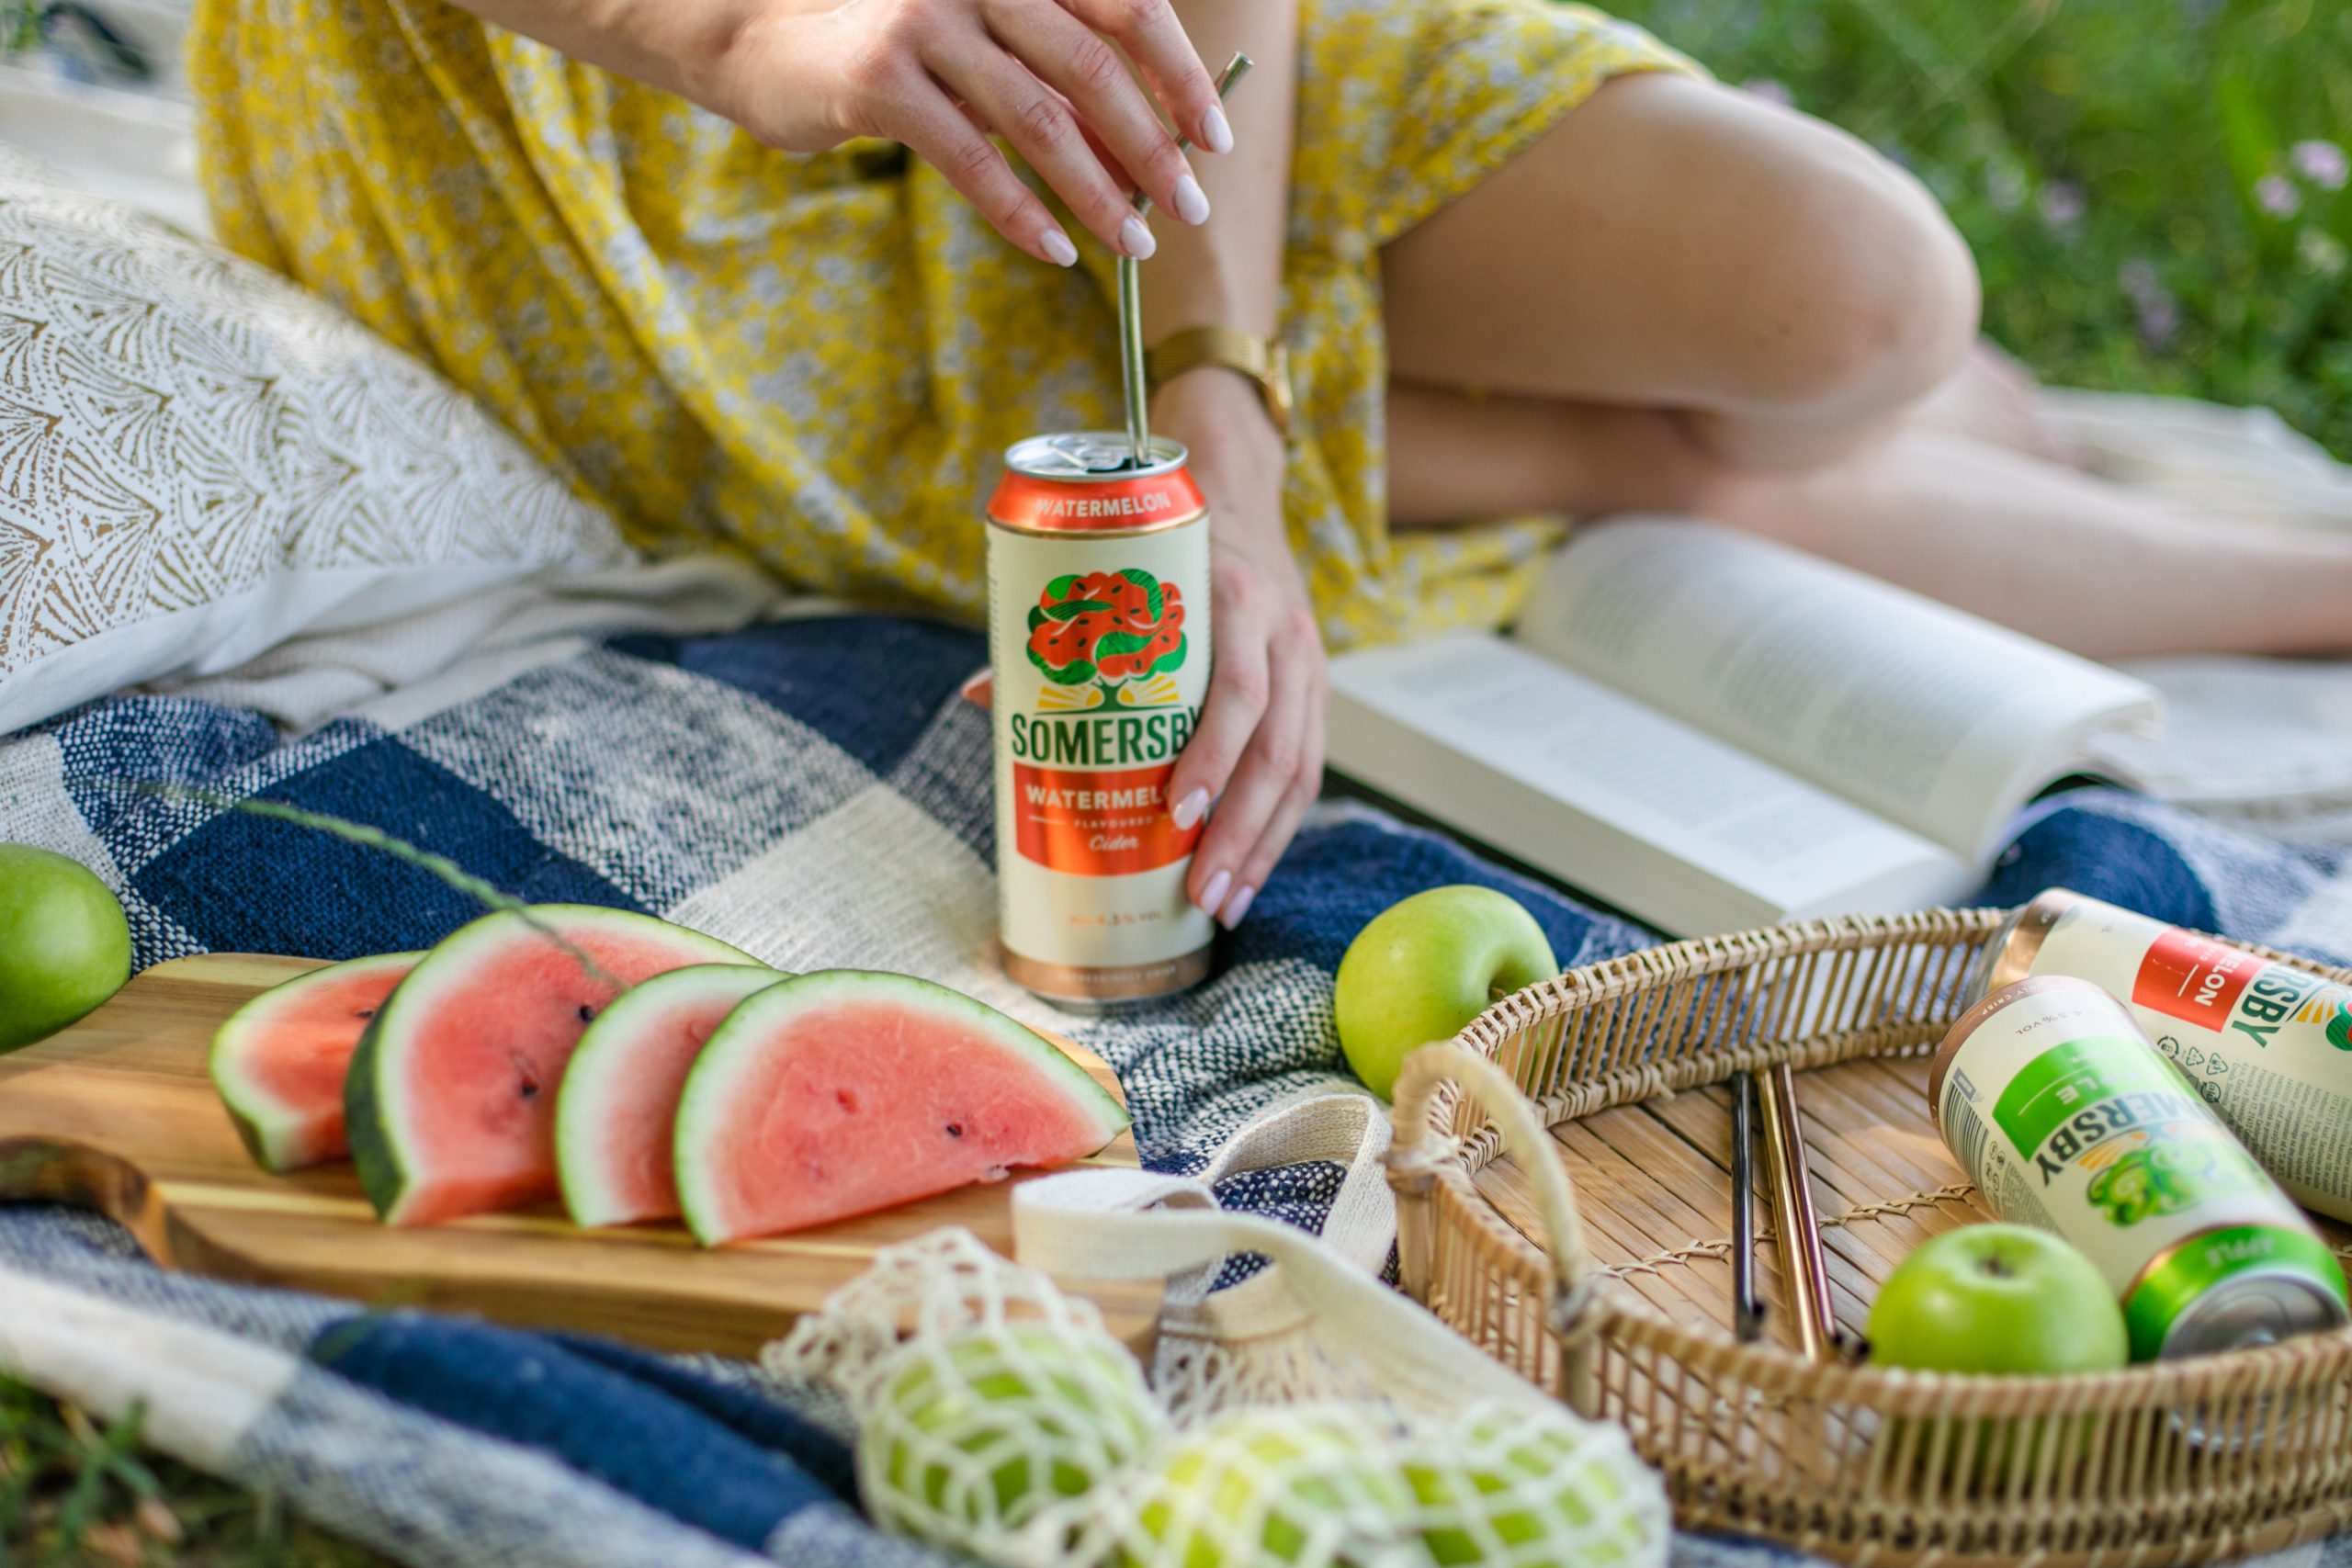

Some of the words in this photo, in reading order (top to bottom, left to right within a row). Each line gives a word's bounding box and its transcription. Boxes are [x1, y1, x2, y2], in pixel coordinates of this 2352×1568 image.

[1035, 491, 1171, 519] WATERMELON
[1073, 815, 1154, 829] FLAVOURED
[1089, 834, 1140, 852] Cider
[2231, 964, 2311, 1049] RSBY
[2015, 1018, 2042, 1036] VOL
